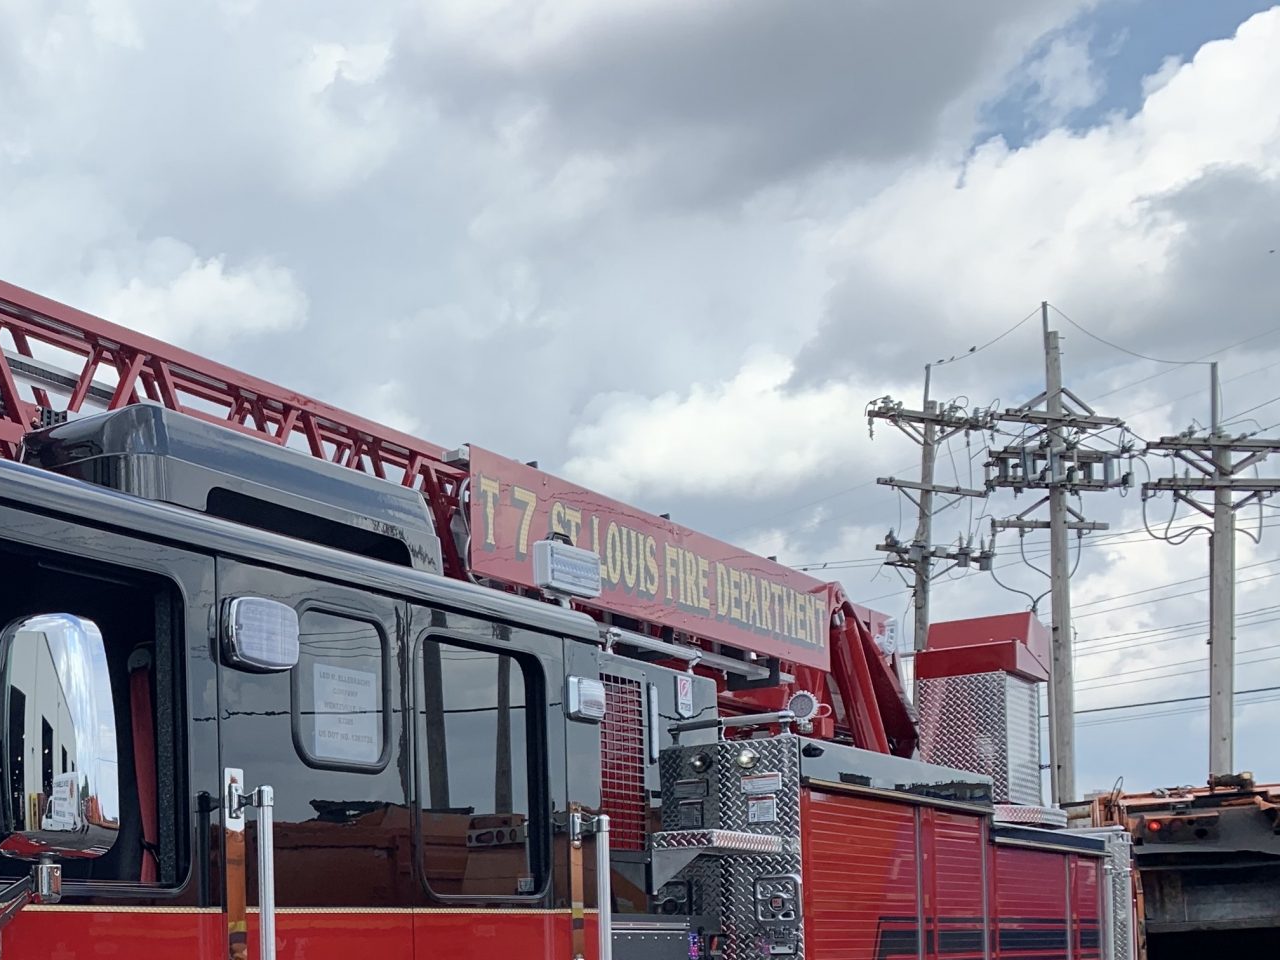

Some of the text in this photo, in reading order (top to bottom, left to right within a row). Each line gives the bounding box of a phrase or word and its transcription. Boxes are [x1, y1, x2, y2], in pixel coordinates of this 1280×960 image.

[480, 474, 500, 546] T
[513, 486, 537, 555] 7
[591, 515, 659, 596] LOUIS
[665, 541, 711, 612] FIRE
[716, 560, 826, 649] DEPARTMENT
